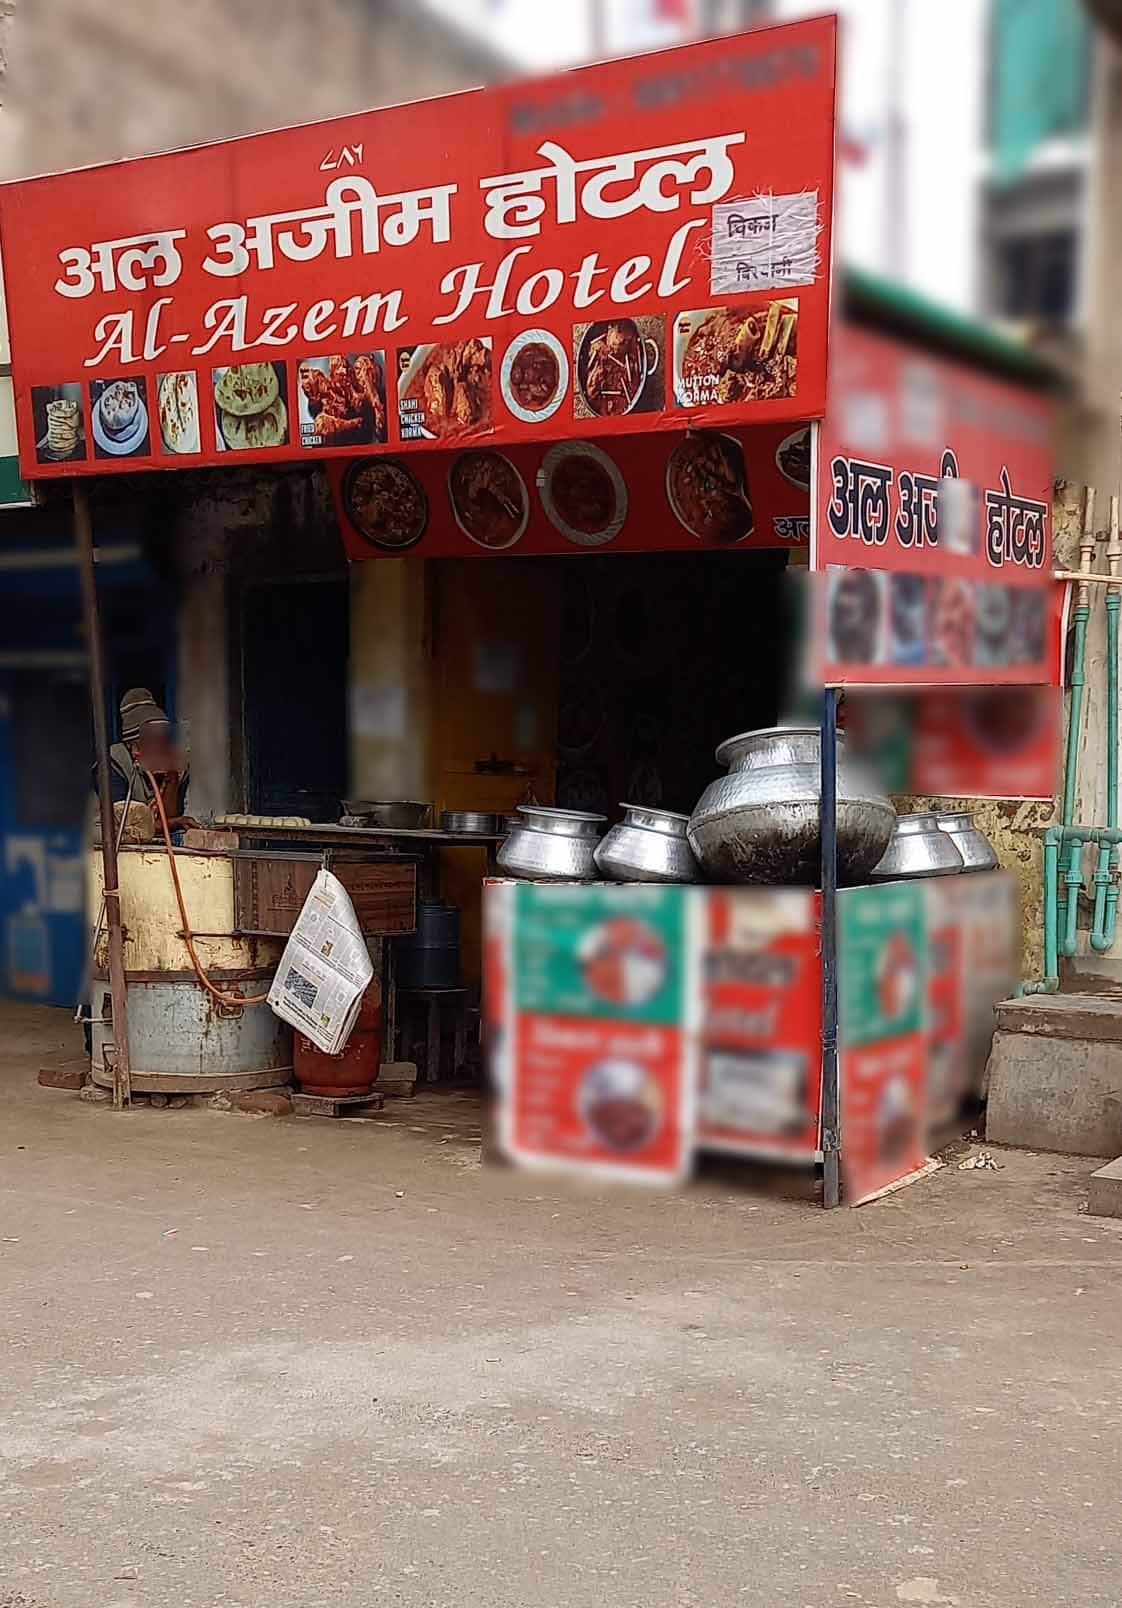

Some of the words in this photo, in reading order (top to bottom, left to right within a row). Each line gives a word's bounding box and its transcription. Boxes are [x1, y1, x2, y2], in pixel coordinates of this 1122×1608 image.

[55, 229, 186, 298] अल
[201, 176, 458, 277] अजीम
[479, 131, 746, 239] होटल
[84, 289, 408, 368] Al-Azem
[432, 218, 710, 325] Hotel
[828, 455, 893, 546] अल
[985, 465, 1048, 569] होटल
